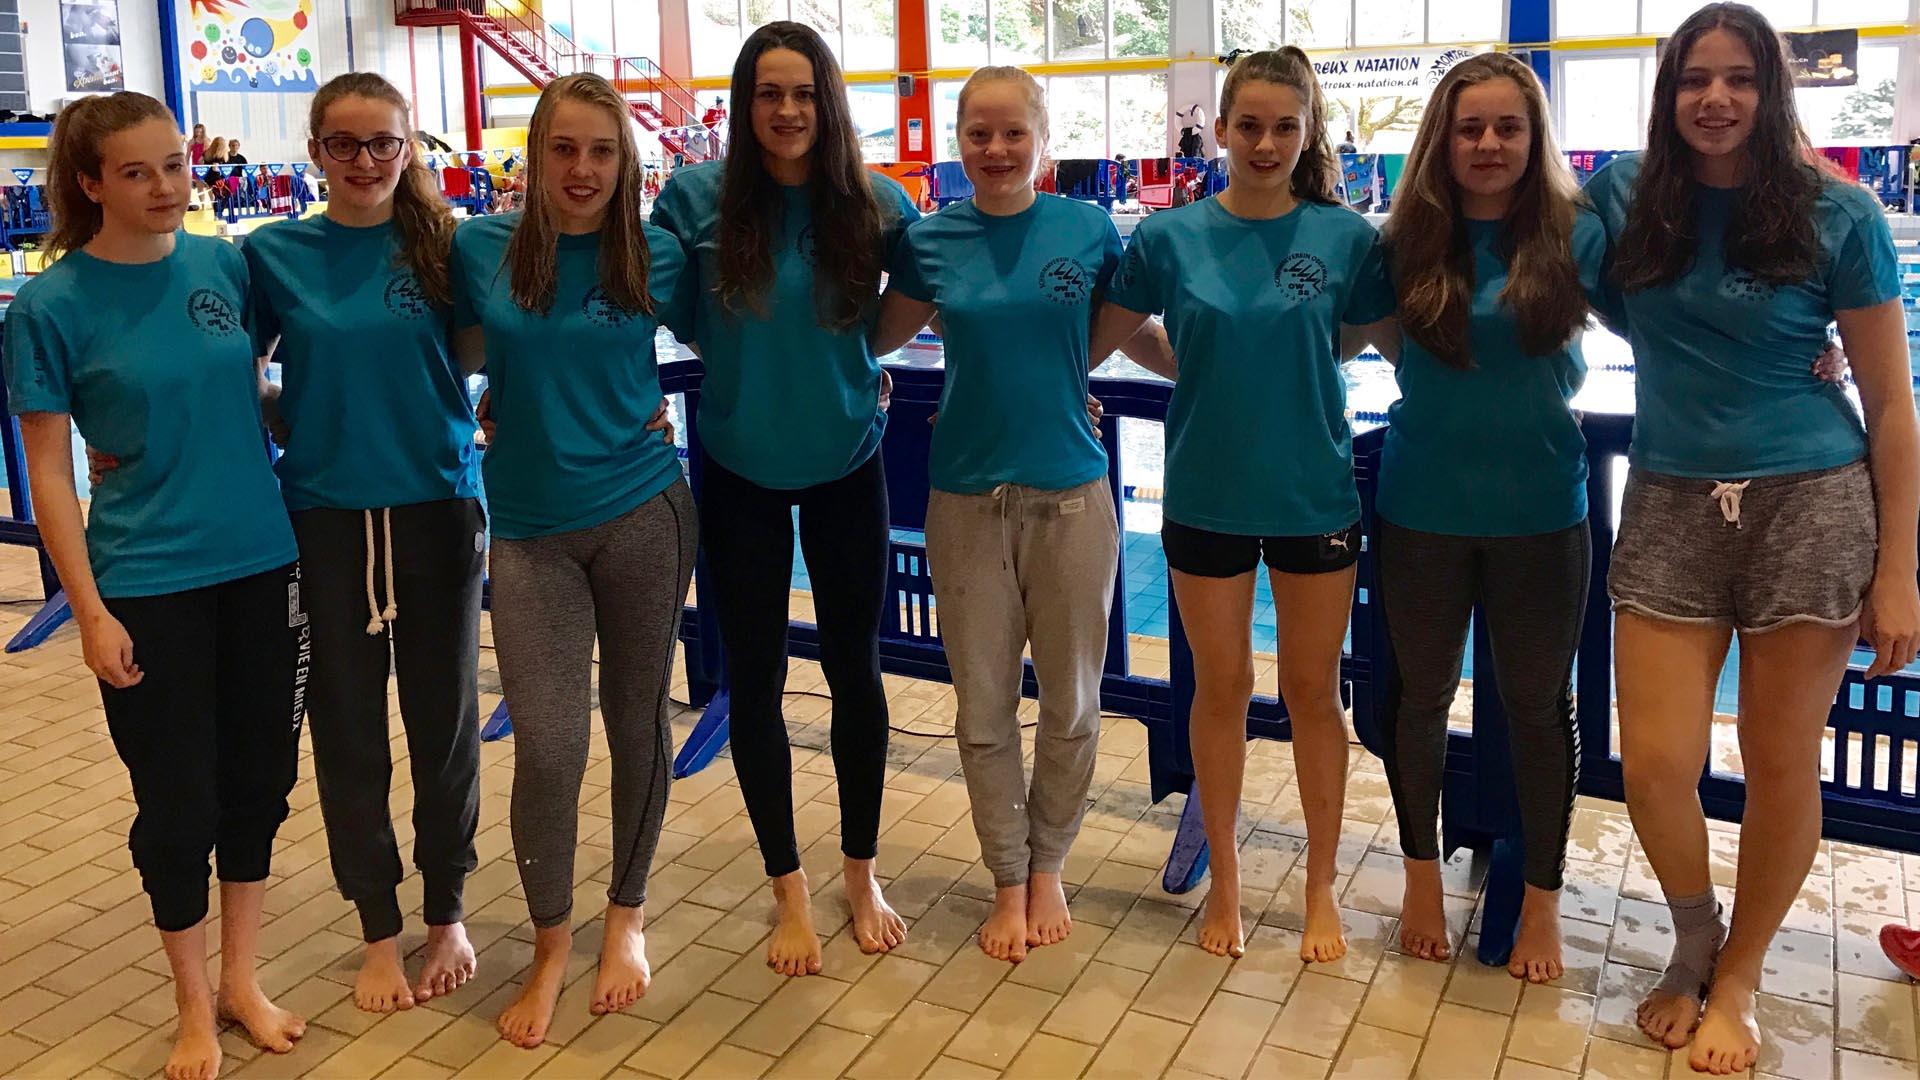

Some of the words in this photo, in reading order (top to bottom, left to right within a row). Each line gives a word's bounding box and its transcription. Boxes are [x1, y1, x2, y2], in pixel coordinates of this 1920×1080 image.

[1313, 60, 1348, 75] REUX
[1353, 56, 1420, 72] NATATION
[1430, 49, 1475, 69] MONTRE
[298, 640, 311, 665] VIE
[295, 666, 309, 685] EN
[292, 686, 305, 732] MIEUX
